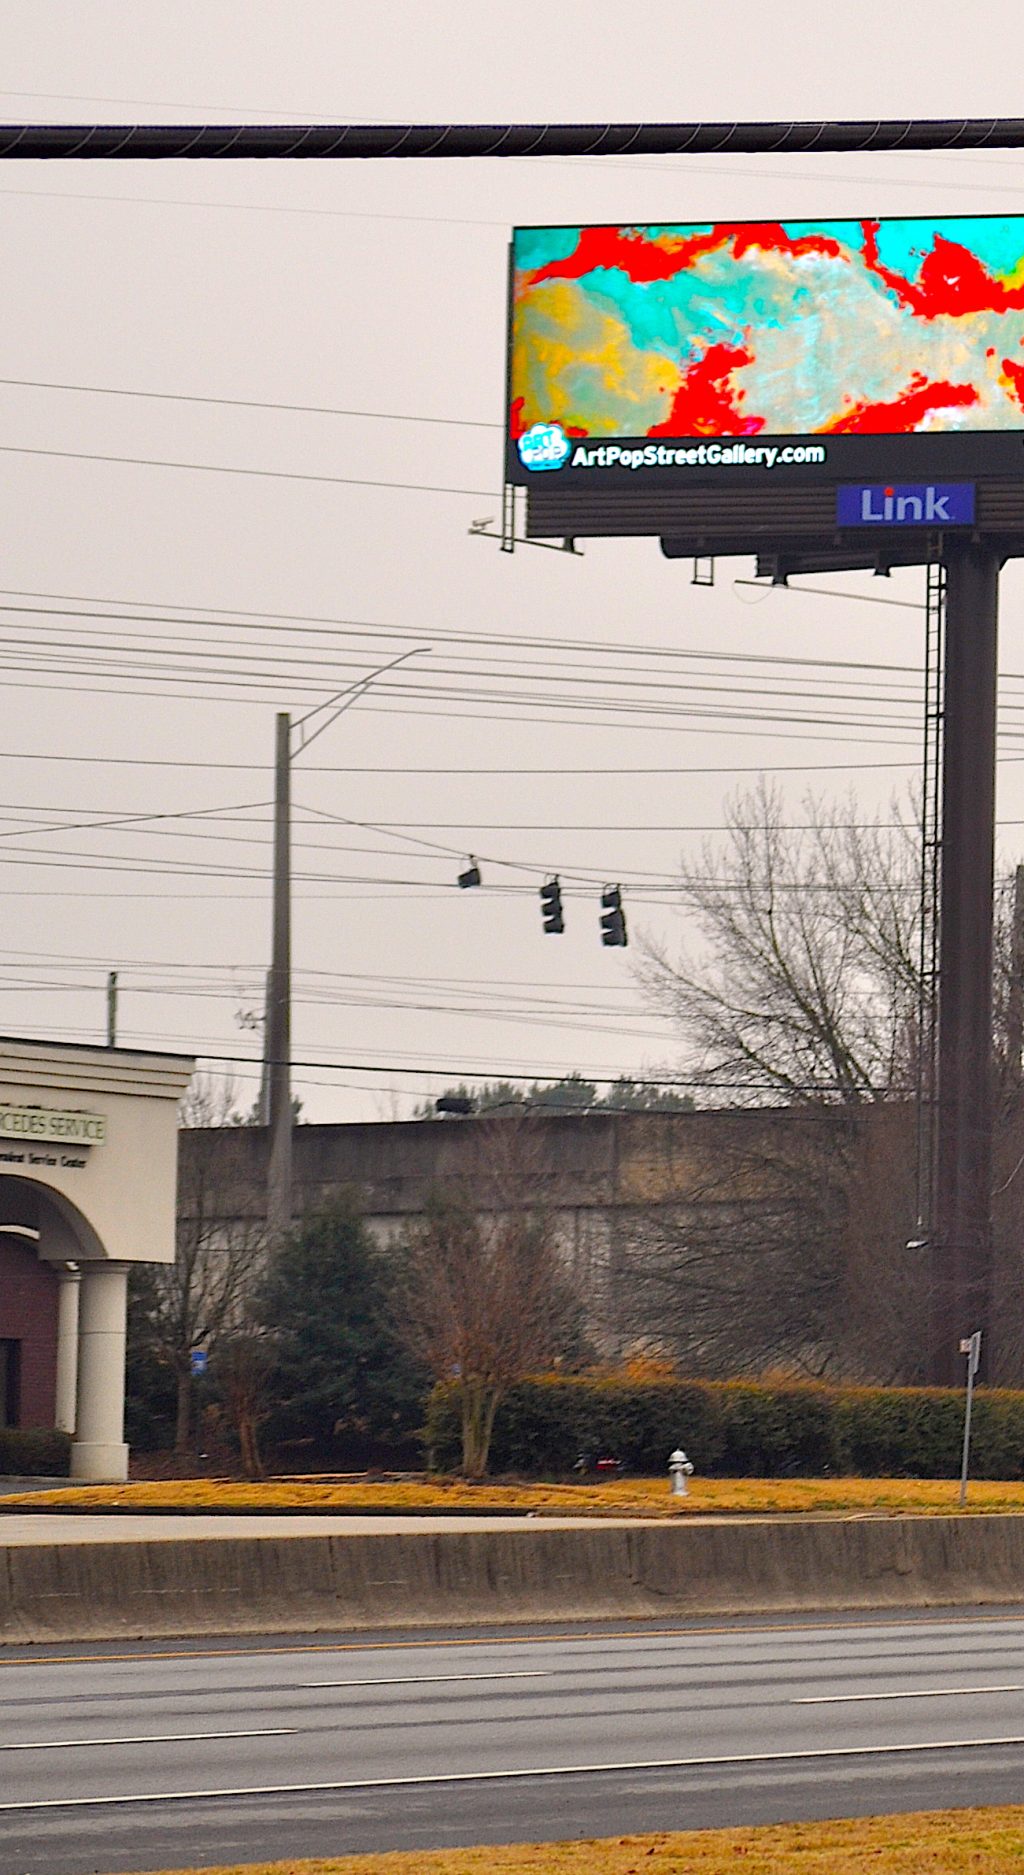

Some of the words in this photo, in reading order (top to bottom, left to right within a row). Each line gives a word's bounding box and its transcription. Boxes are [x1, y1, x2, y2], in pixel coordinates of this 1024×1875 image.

[571, 444, 825, 468] ArtPopStreetGallery.com
[861, 486, 950, 521] Link
[50, 1116, 104, 1140] SERVICE
[28, 1153, 57, 1166] Service
[61, 1155, 87, 1169] Center
